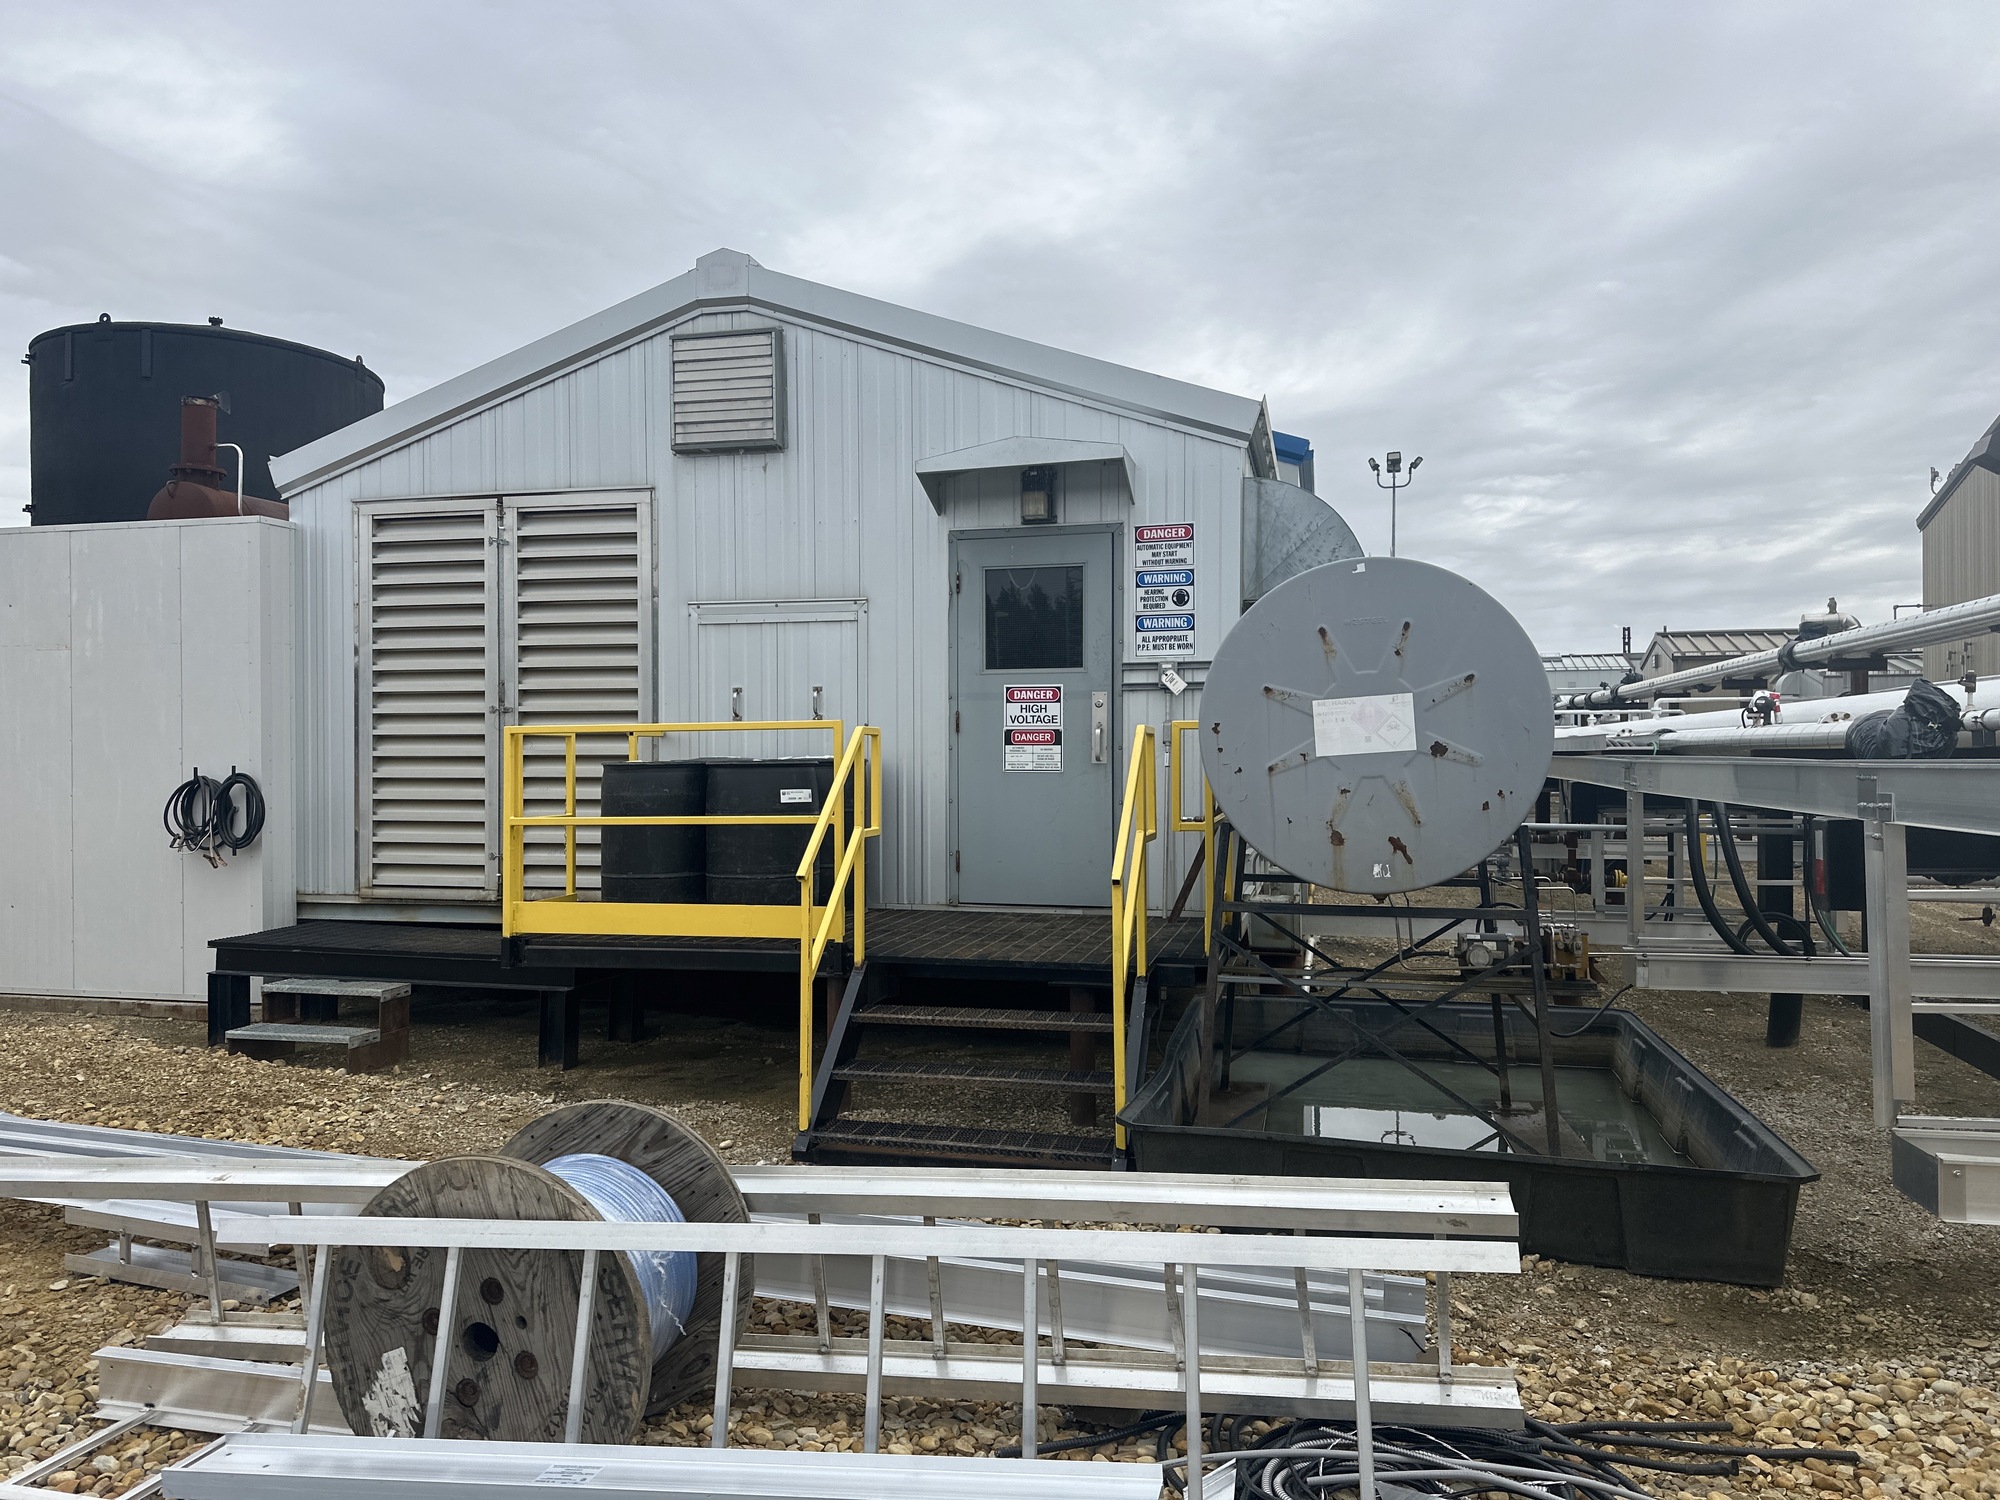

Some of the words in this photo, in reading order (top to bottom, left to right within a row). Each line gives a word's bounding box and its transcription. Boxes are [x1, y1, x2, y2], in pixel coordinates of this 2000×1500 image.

[1143, 527, 1186, 539] DANGER
[1136, 543, 1164, 551] AUTOMATIC
[1164, 541, 1192, 550] EQUIPMENT
[1142, 558, 1164, 566] WITHOUT
[1143, 572, 1186, 584] WARNING
[1139, 595, 1169, 603] PROTECTION
[1142, 602, 1166, 610] REQUIRED
[1142, 617, 1188, 629] WARNING
[1141, 635, 1151, 643] ALL
[1151, 634, 1189, 643] APPROPRIATE
[1152, 643, 1167, 651] MUST
[1168, 642, 1176, 650] BE
[1176, 642, 1194, 651] WORN
[1013, 690, 1054, 700] DANGER
[1020, 704, 1048, 713] HIGH
[1009, 715, 1059, 724] VOLTAGE
[1014, 733, 1052, 742] DANGER
